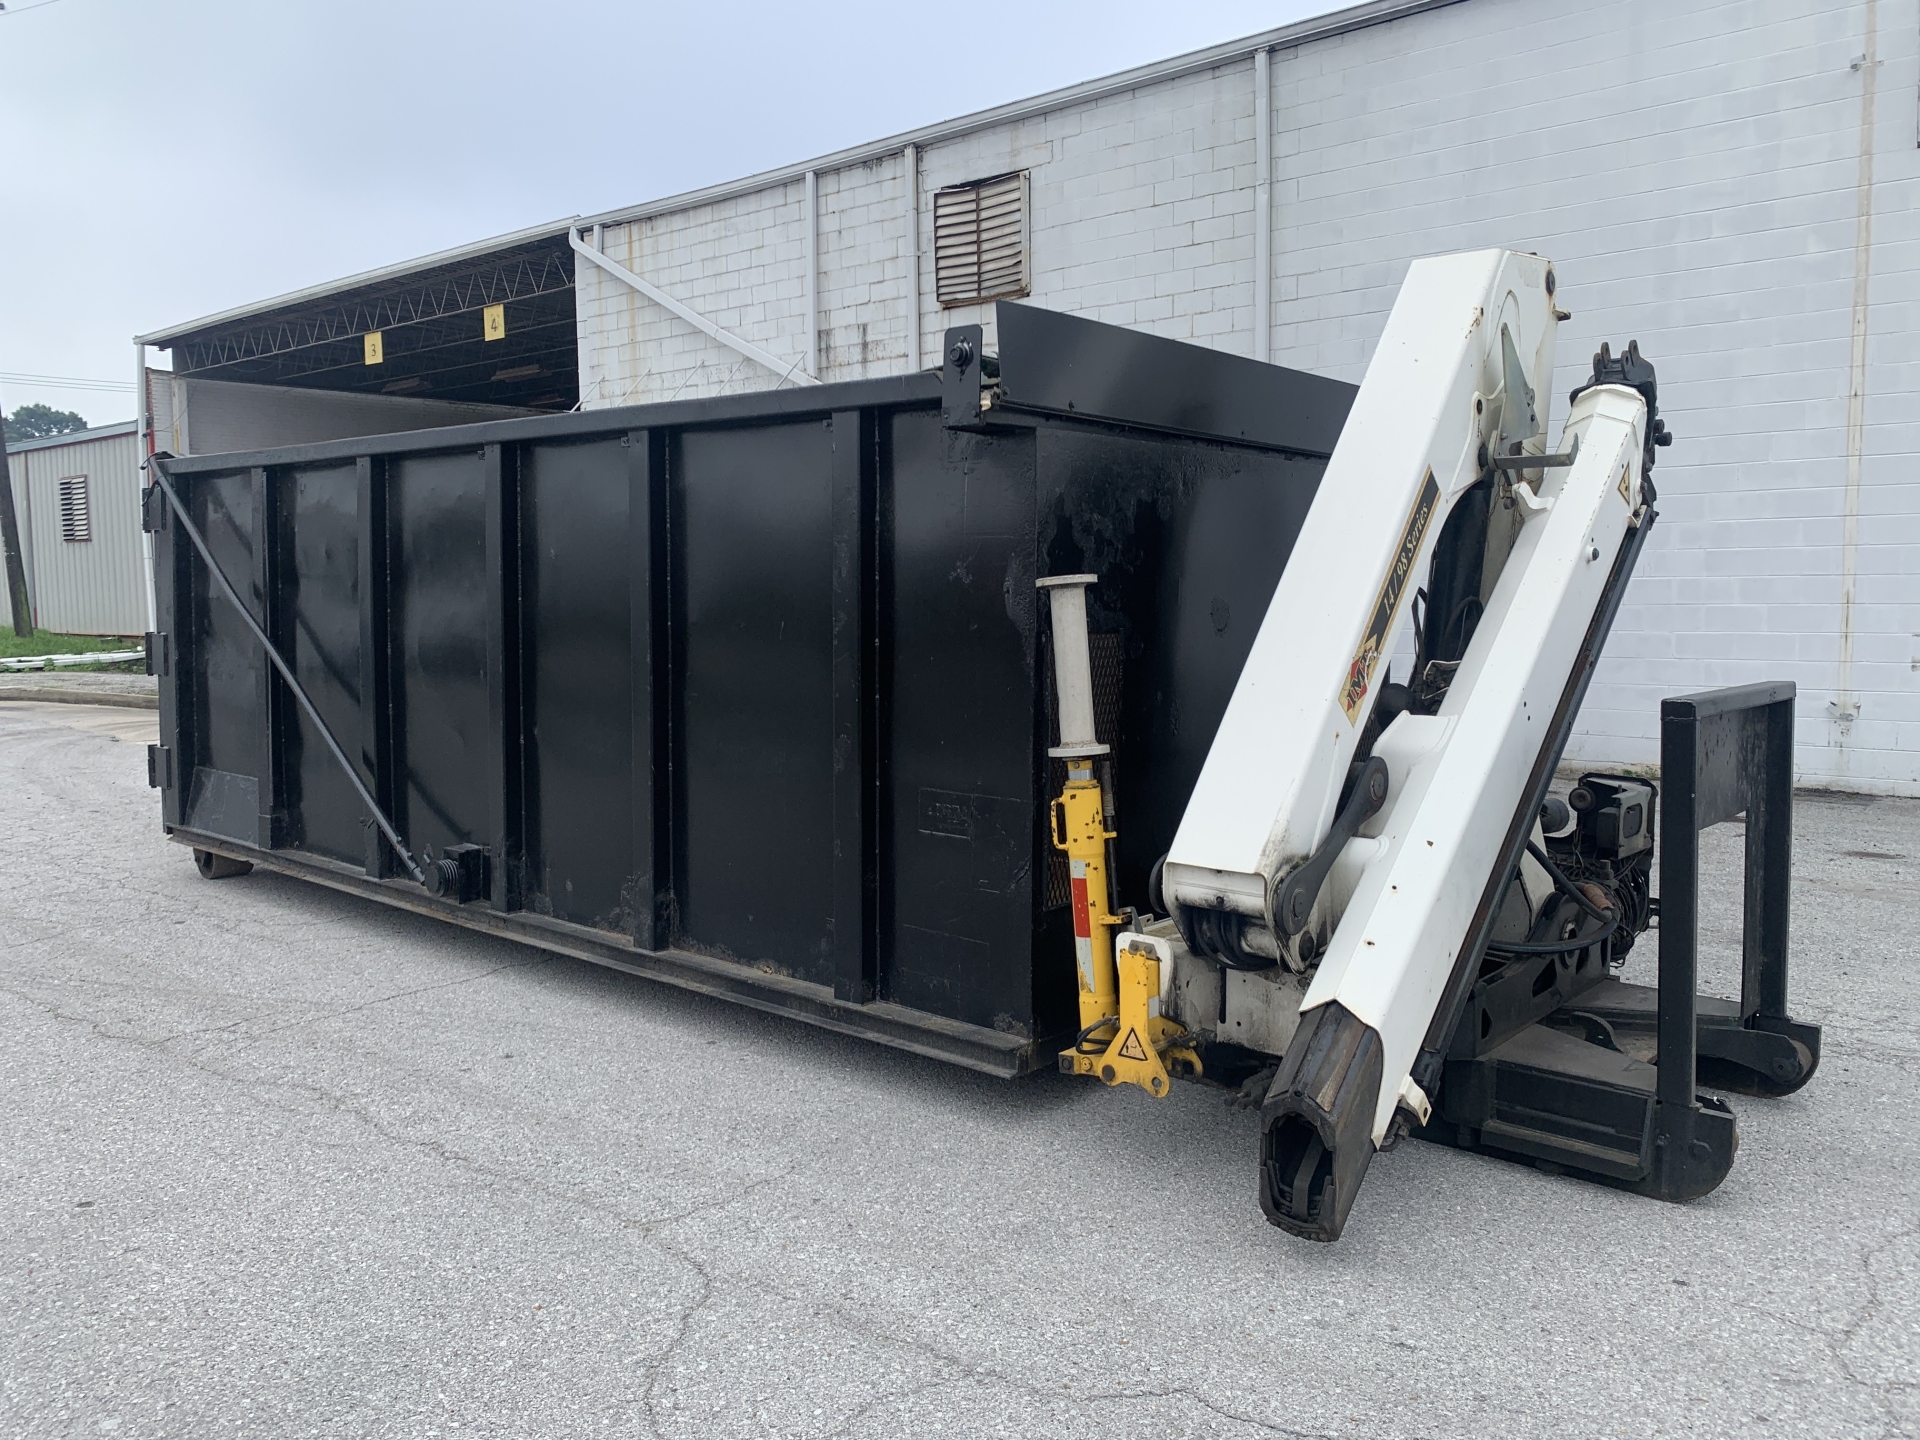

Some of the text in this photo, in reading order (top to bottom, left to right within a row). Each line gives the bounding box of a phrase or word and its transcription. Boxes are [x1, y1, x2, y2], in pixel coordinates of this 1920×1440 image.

[491, 317, 498, 333] 4
[370, 343, 377, 357] 3
[1406, 502, 1428, 558] Series
